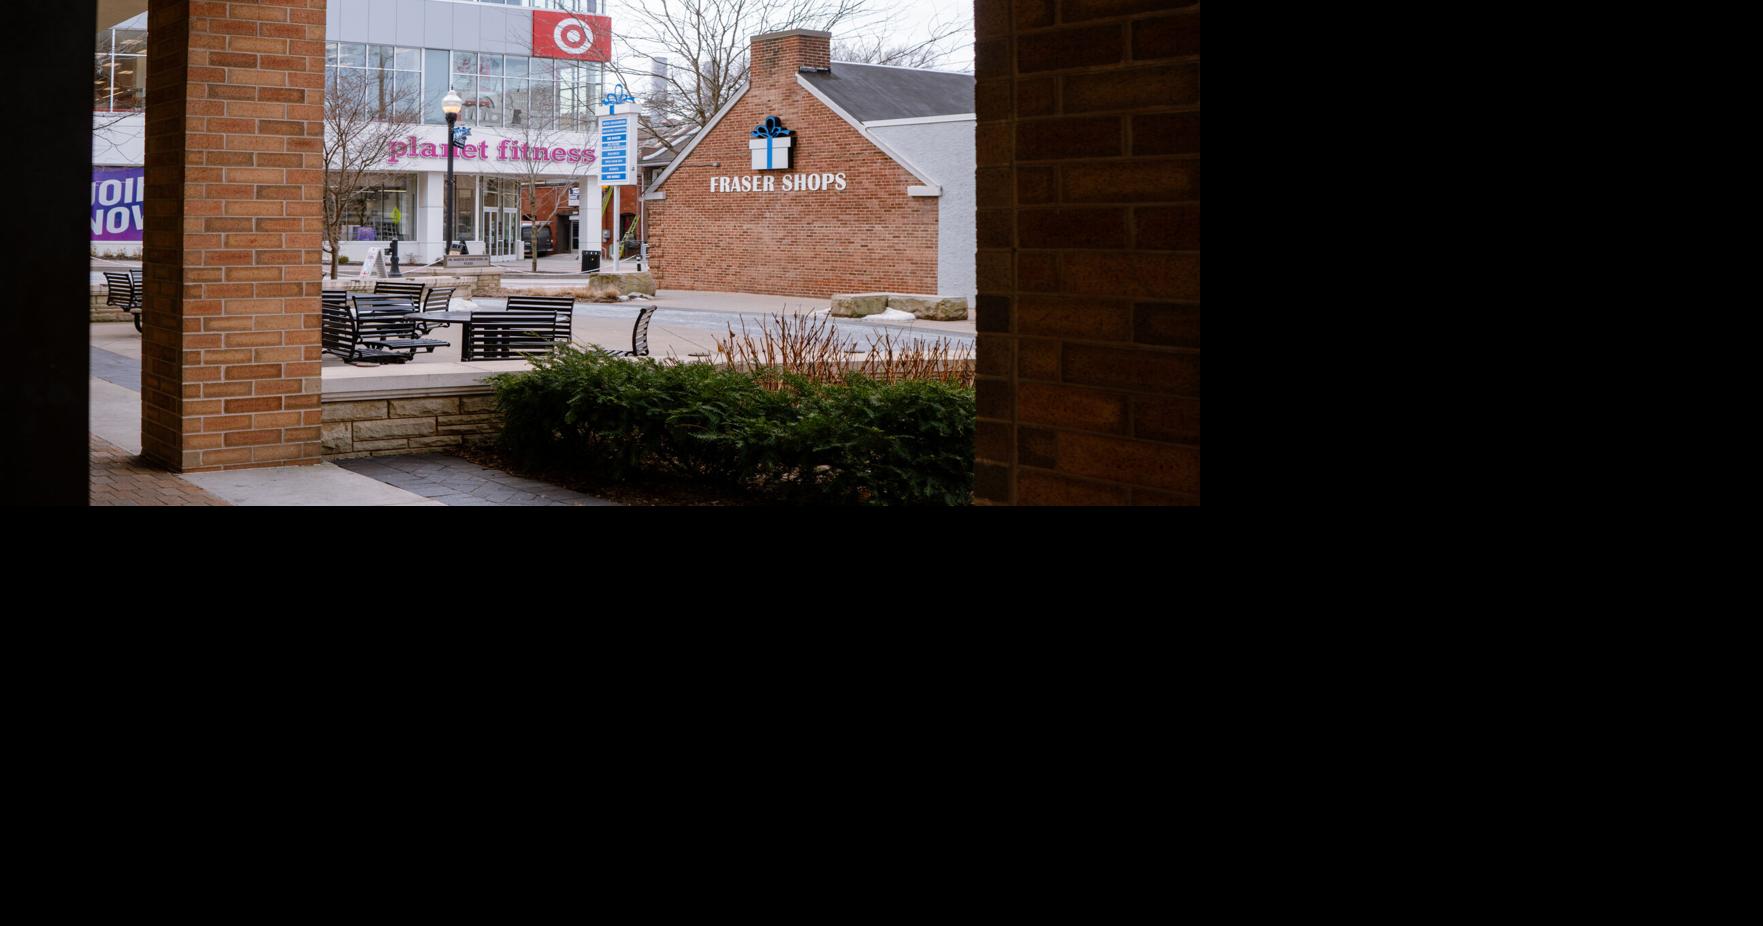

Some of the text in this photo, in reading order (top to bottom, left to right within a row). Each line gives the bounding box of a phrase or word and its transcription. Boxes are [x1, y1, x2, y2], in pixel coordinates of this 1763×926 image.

[387, 136, 488, 164] planet
[496, 138, 596, 163] fitness
[710, 172, 847, 193] FRASER SHOPS
